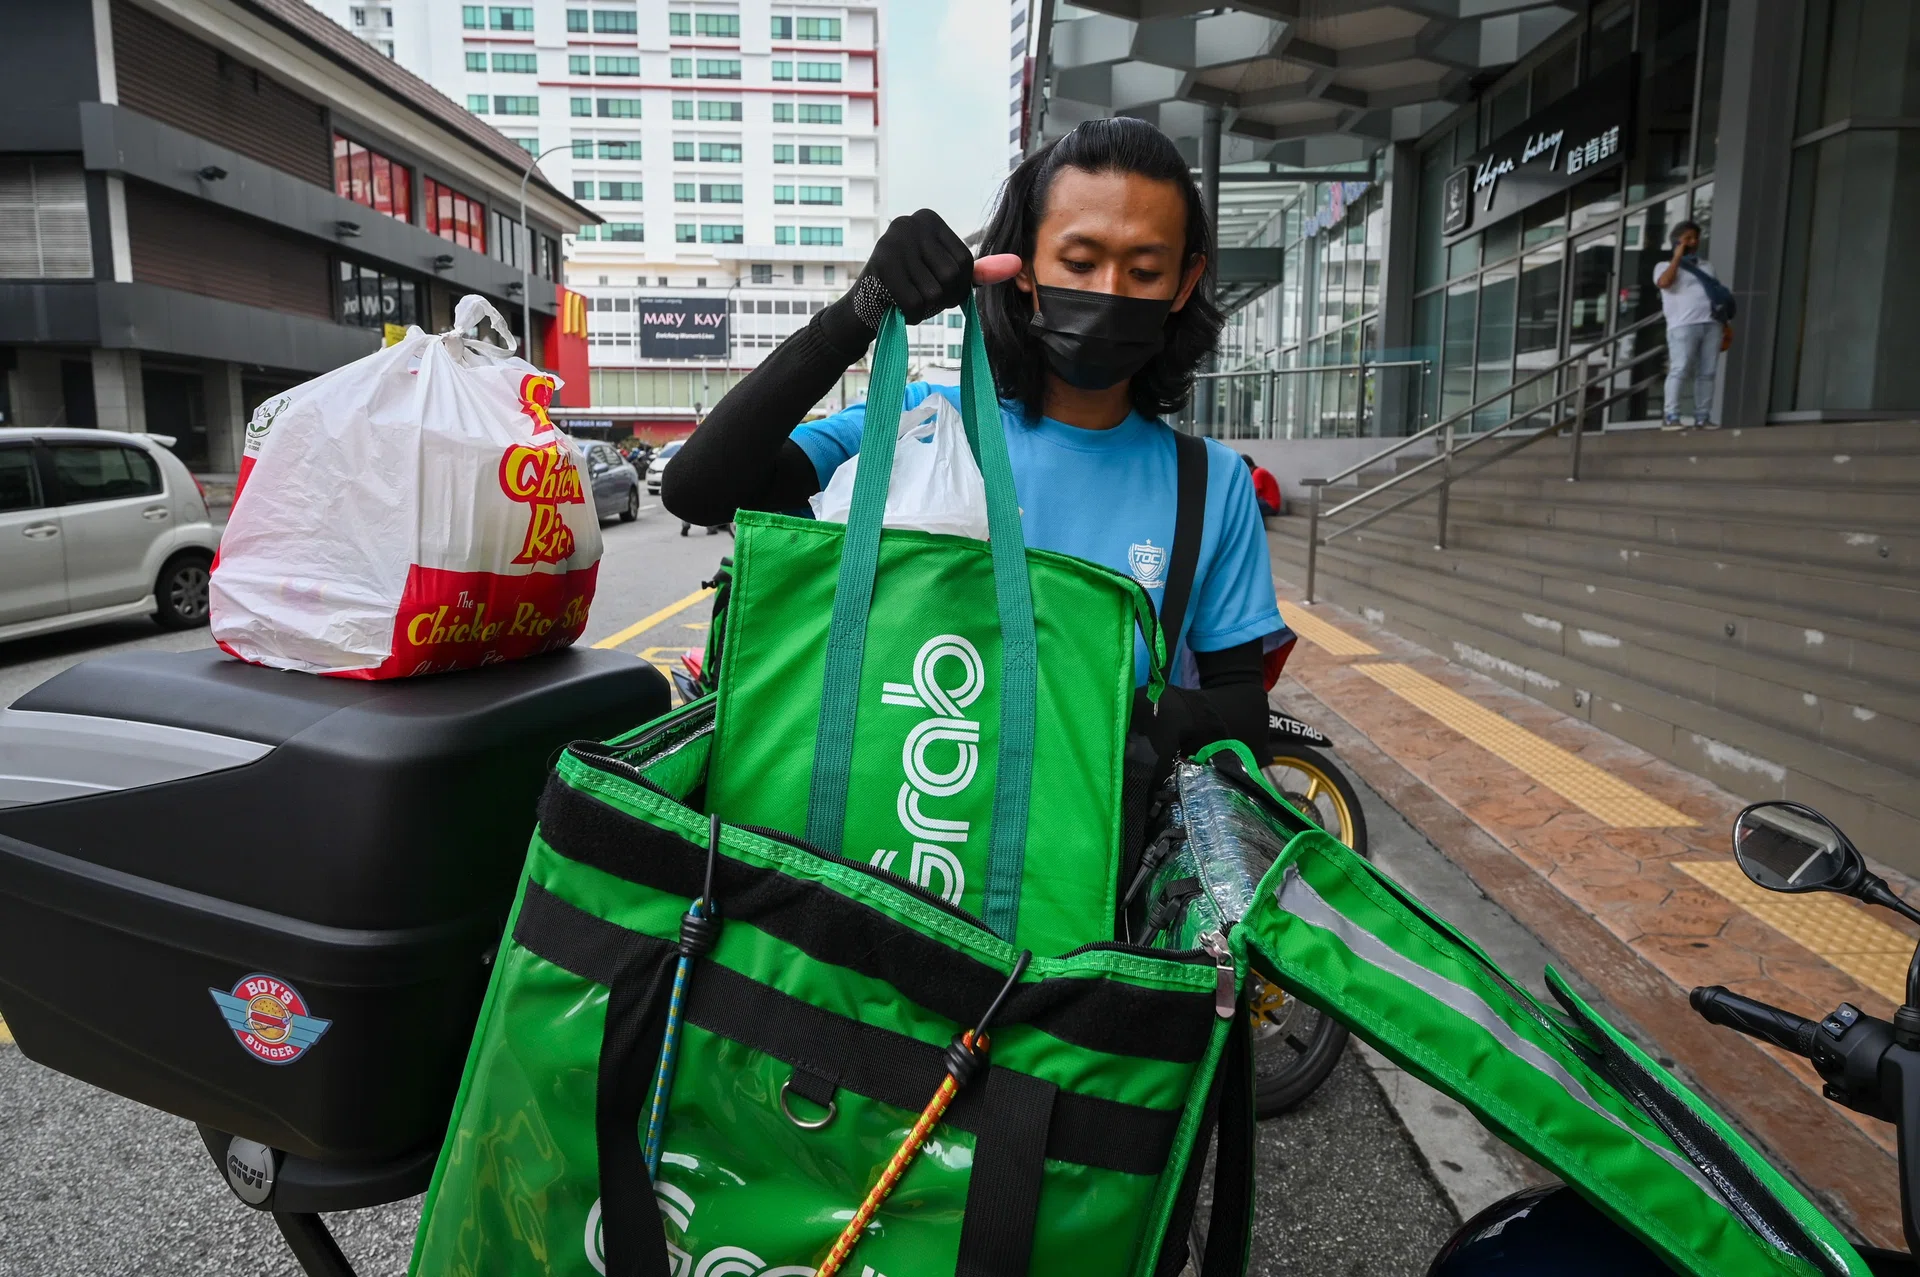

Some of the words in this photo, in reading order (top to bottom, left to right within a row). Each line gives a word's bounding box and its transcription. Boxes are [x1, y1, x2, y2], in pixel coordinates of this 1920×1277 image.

[643, 312, 686, 328] MARY
[694, 312, 724, 328] KAY
[1134, 551, 1161, 564] TOC
[456, 590, 474, 609] The
[245, 979, 294, 1005] BOY'S
[245, 1034, 295, 1058] BURGER
[228, 1154, 264, 1190] GIVI
